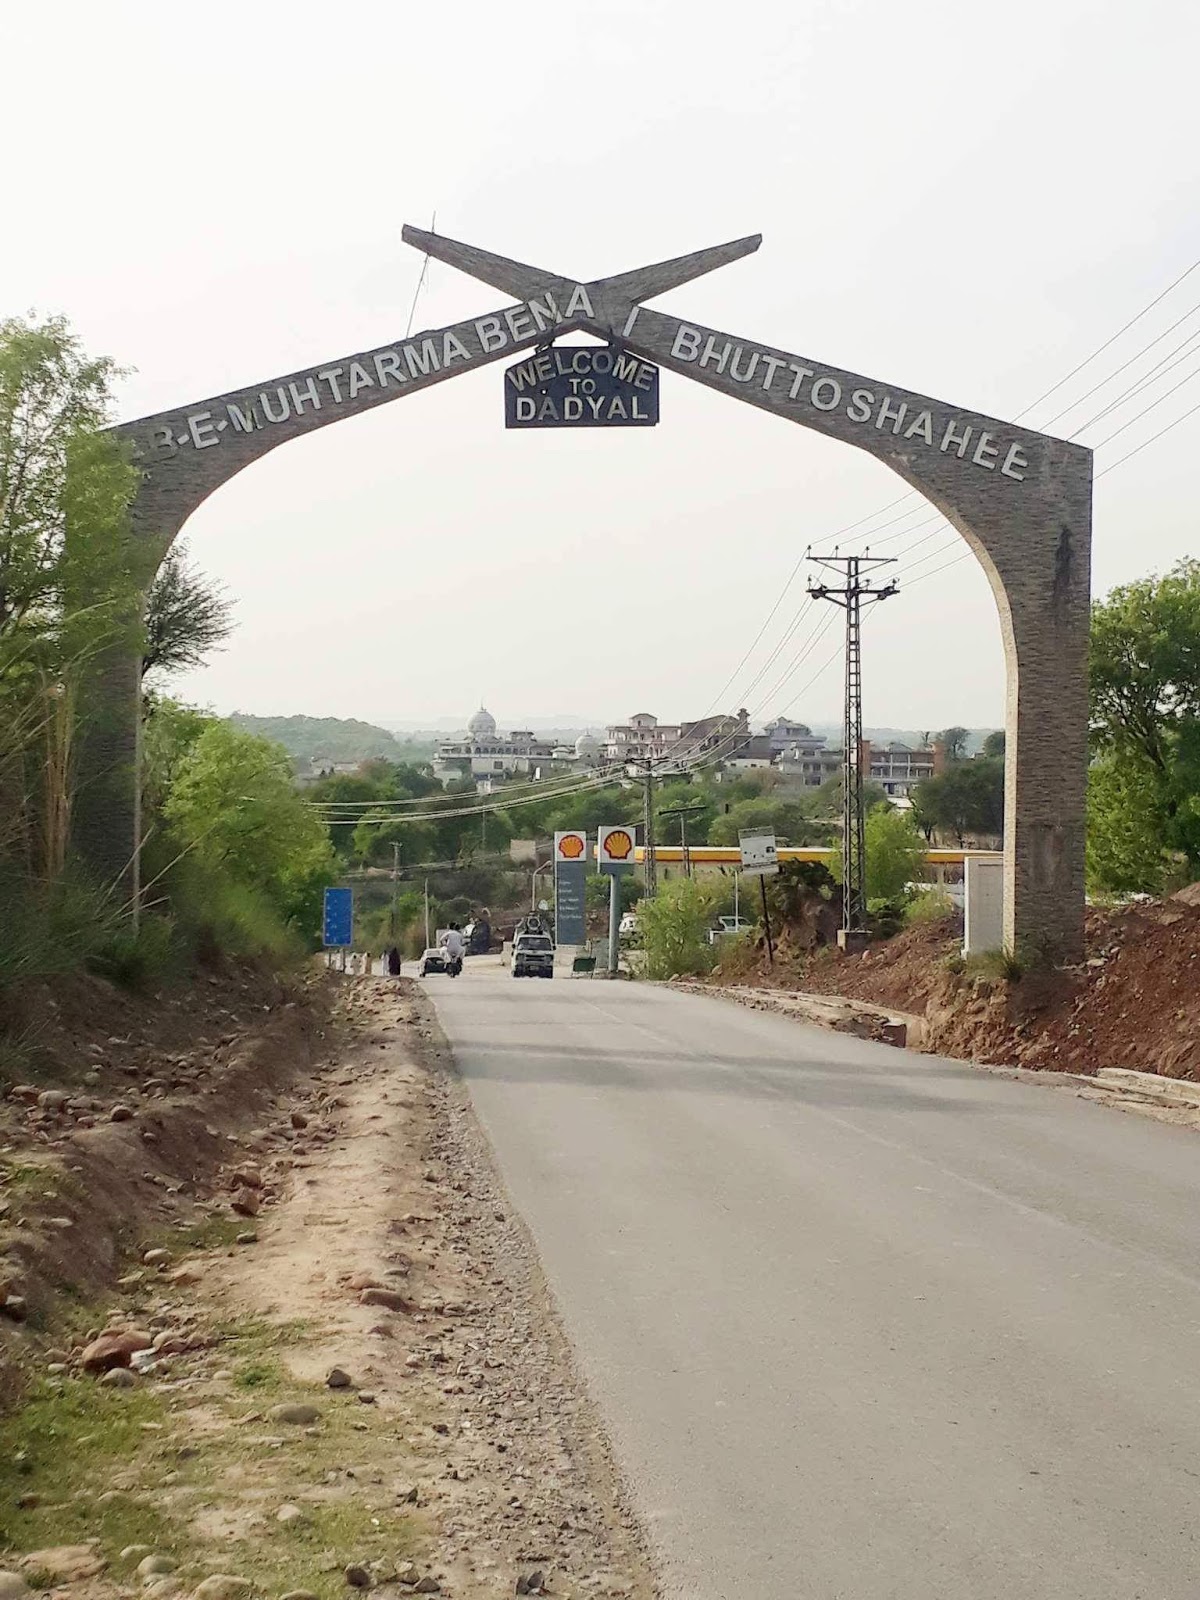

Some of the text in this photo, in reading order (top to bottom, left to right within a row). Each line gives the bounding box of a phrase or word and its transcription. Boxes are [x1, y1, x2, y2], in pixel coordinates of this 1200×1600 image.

[505, 350, 657, 392] WELCOME
[568, 377, 597, 395] TO
[515, 395, 649, 422] DADYAL
